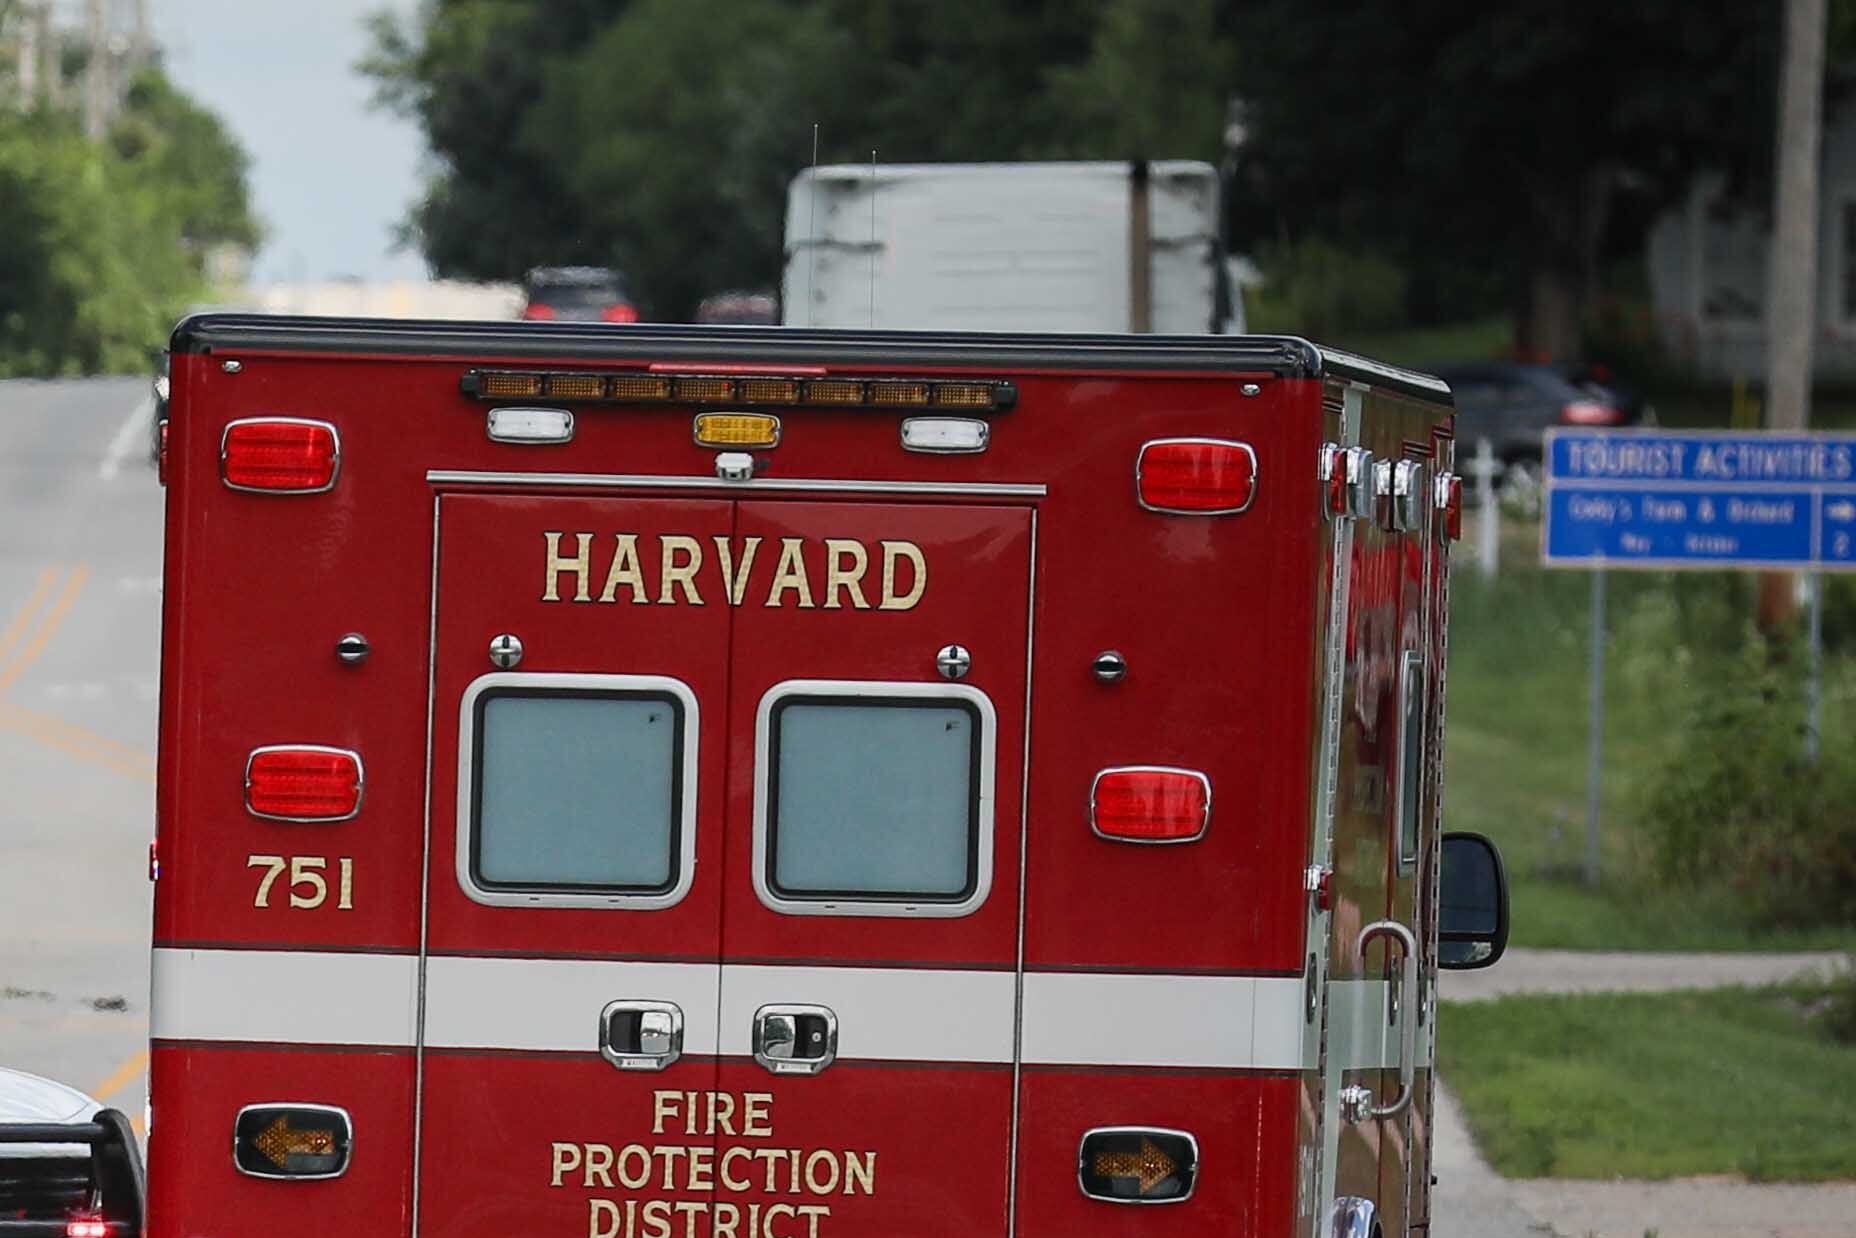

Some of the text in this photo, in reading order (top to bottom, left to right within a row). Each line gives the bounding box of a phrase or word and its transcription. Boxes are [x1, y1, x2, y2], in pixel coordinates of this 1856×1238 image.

[1567, 441, 1852, 480] TOURIST ACTIVITIES
[542, 531, 928, 611] HARVARD
[246, 855, 355, 911] 751
[650, 1090, 774, 1137] FIRE
[550, 1142, 877, 1195] PROTECTION
